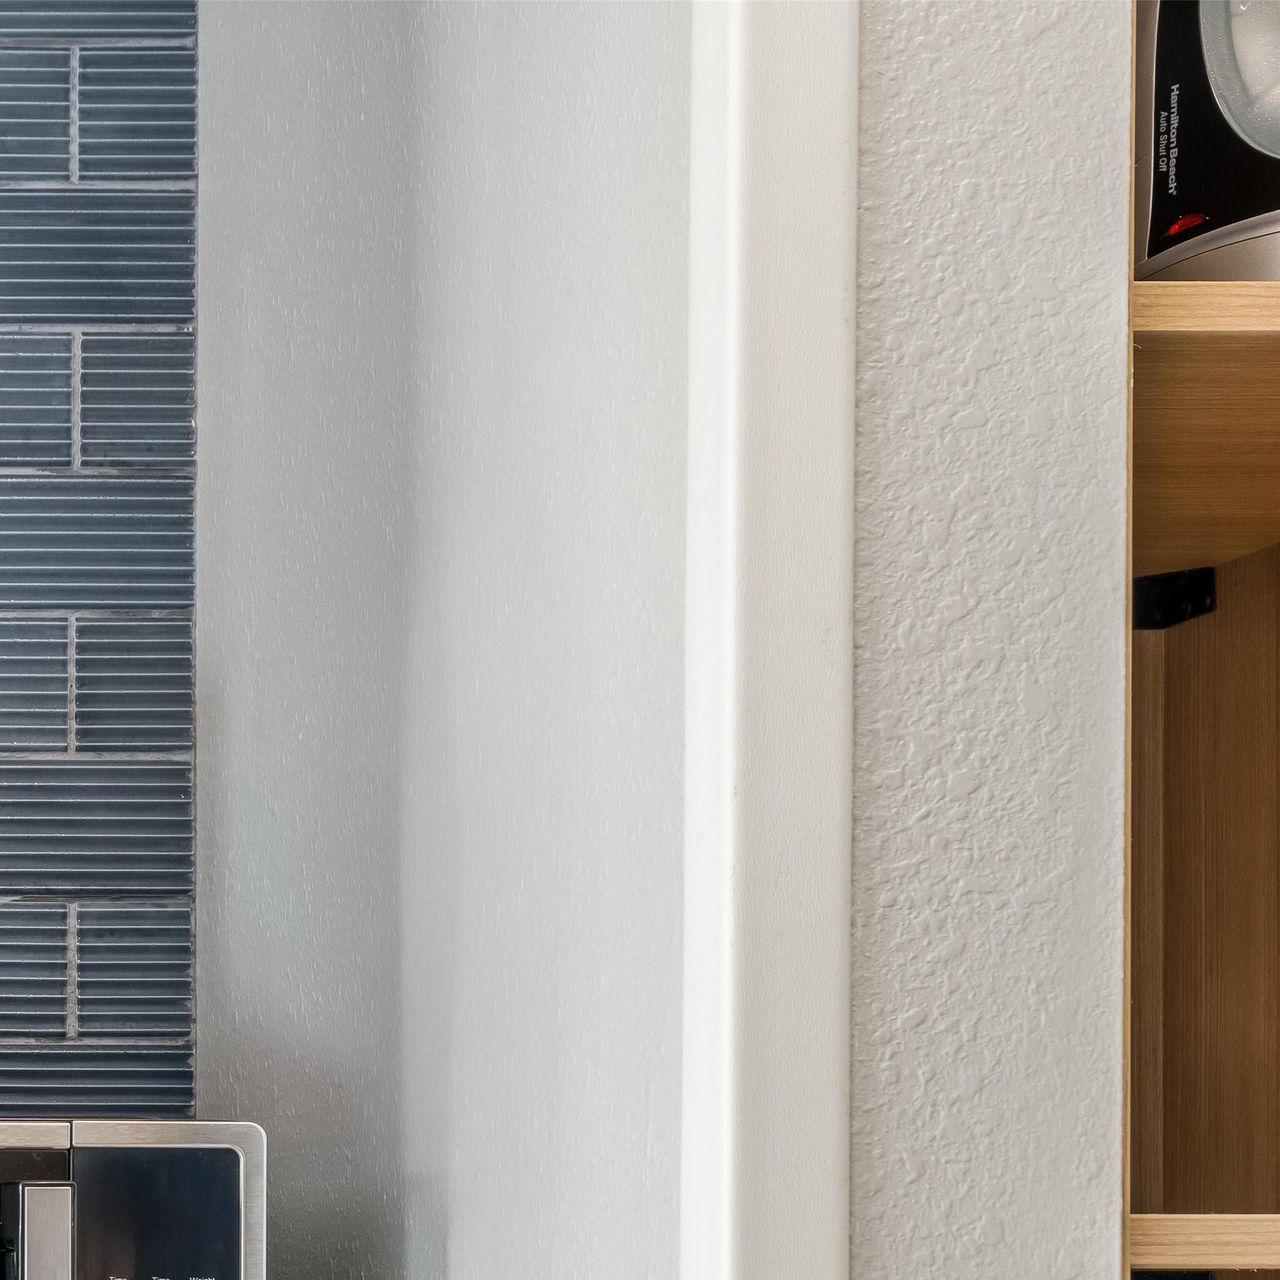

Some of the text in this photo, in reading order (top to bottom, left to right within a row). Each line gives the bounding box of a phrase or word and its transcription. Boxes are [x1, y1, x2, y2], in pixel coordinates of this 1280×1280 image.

[1159, 111, 1168, 172] Auto Shut Off
[1169, 84, 1180, 148] Hamilton
